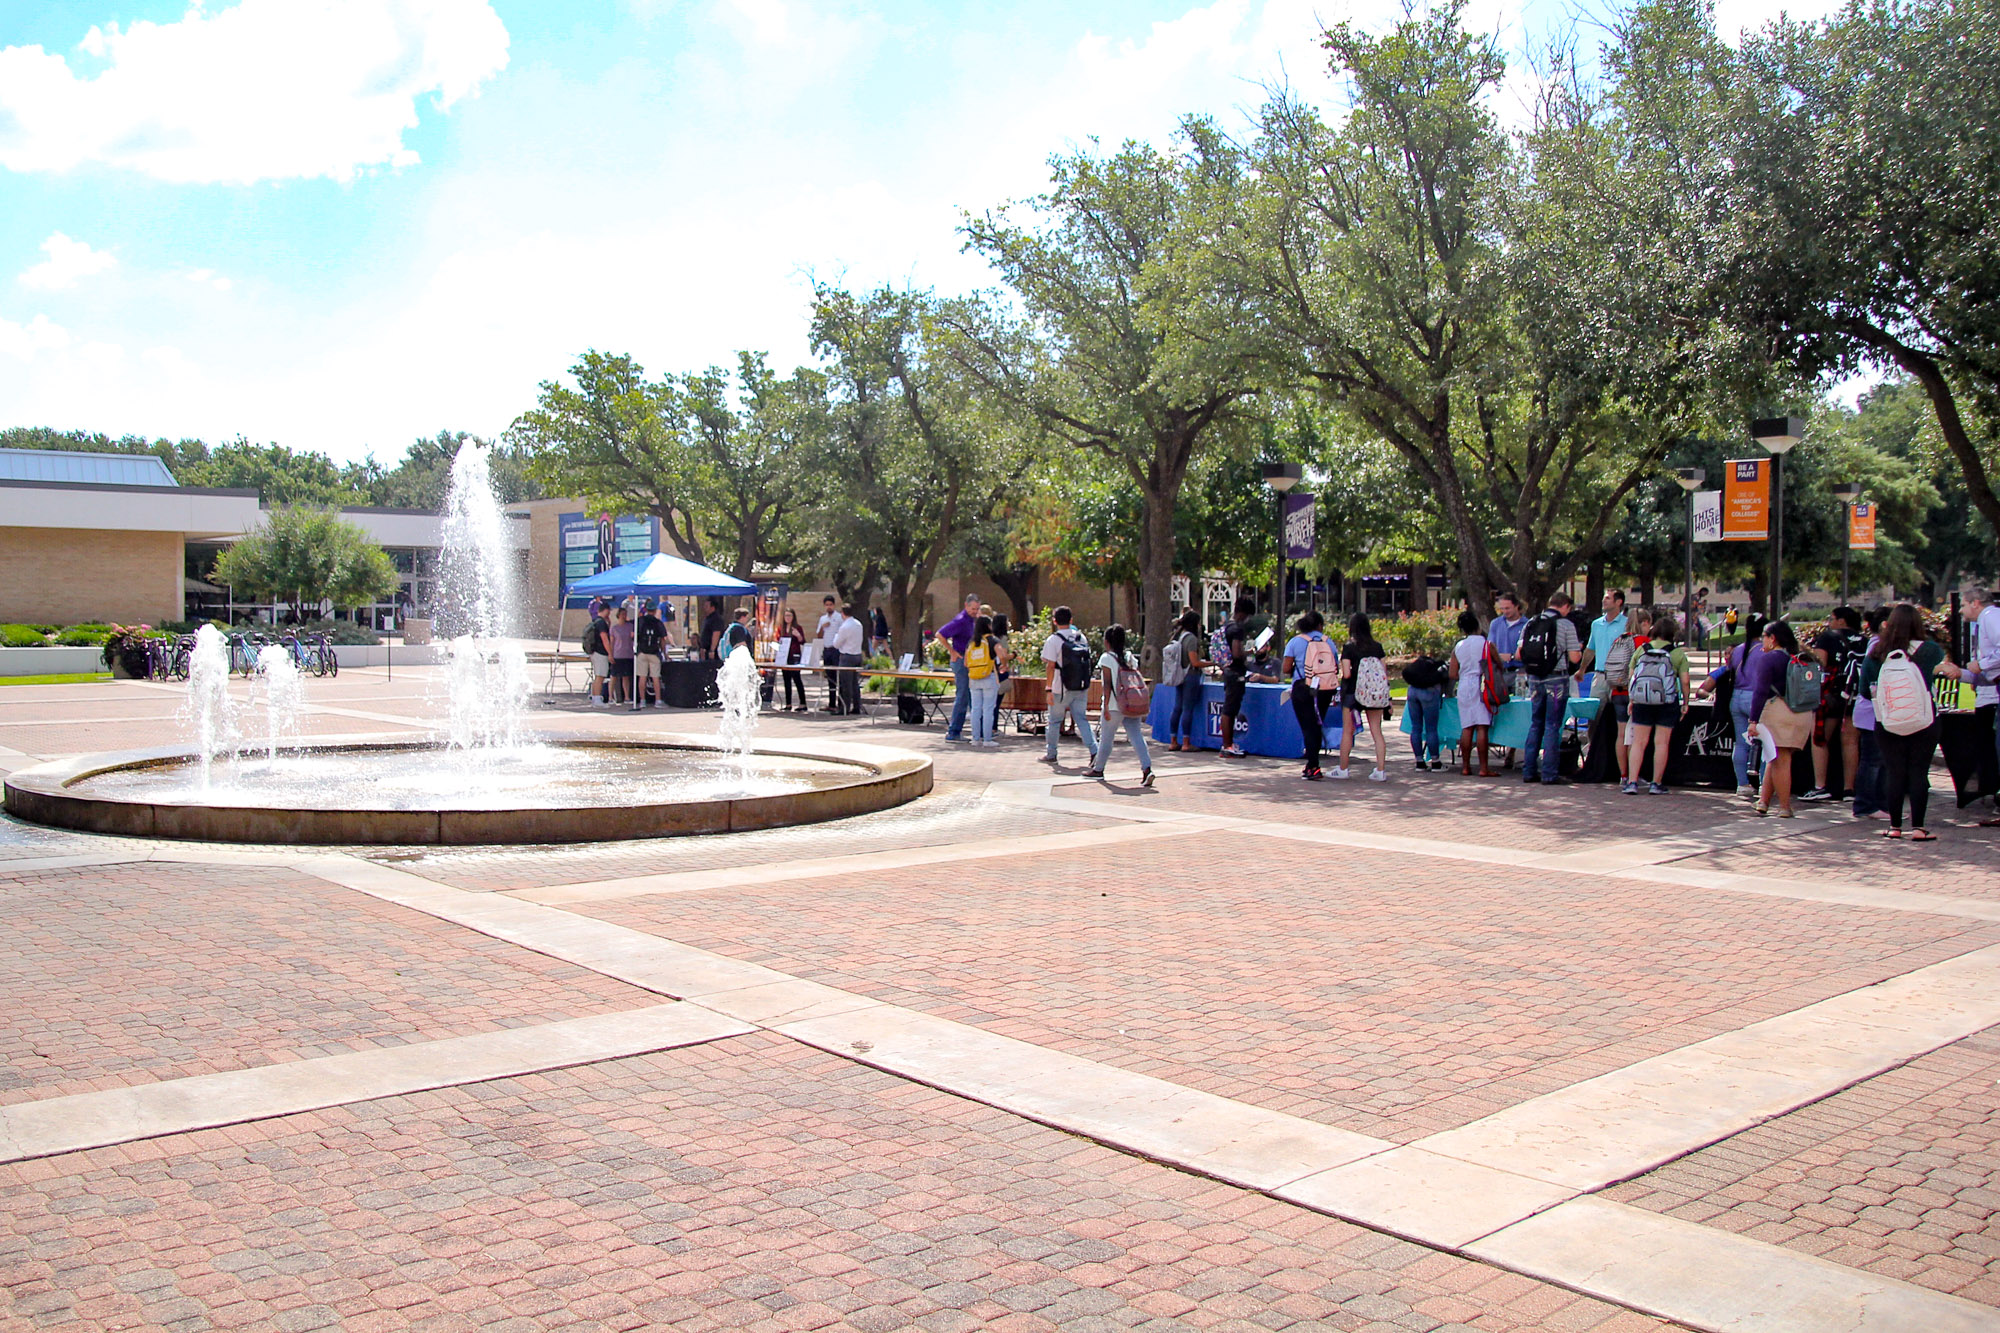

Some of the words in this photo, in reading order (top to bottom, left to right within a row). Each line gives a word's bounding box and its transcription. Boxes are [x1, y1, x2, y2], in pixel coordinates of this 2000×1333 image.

[1693, 507, 1714, 522] THIS
[1285, 515, 1315, 540] PURPLE
[1695, 515, 1720, 533] HOME
[1210, 701, 1223, 715] KT
[1233, 716, 1248, 731] bc
